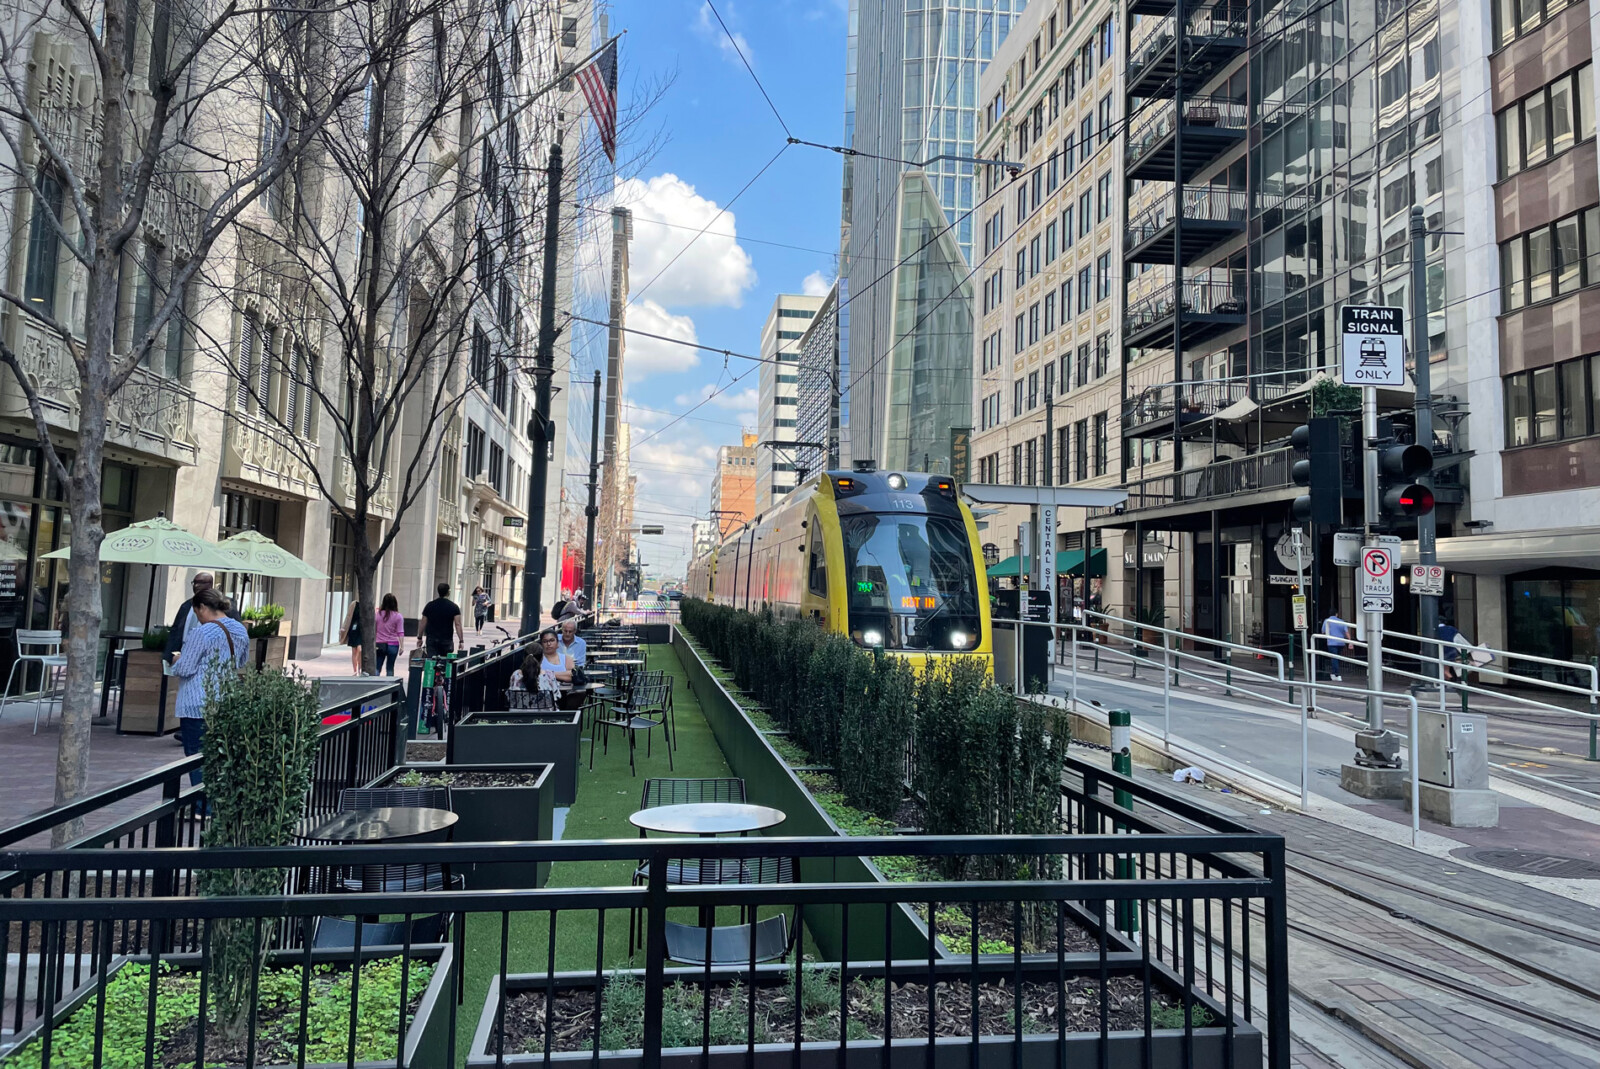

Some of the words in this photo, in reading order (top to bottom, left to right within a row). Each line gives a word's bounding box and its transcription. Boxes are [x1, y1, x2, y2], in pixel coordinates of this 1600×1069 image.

[1352, 309, 1394, 320] TRAIN
[1347, 322, 1399, 333] SIGNAL
[1355, 370, 1392, 379] ONLY
[893, 500, 914, 509] 113
[902, 596, 920, 608] NOT
[925, 596, 935, 608] IN
